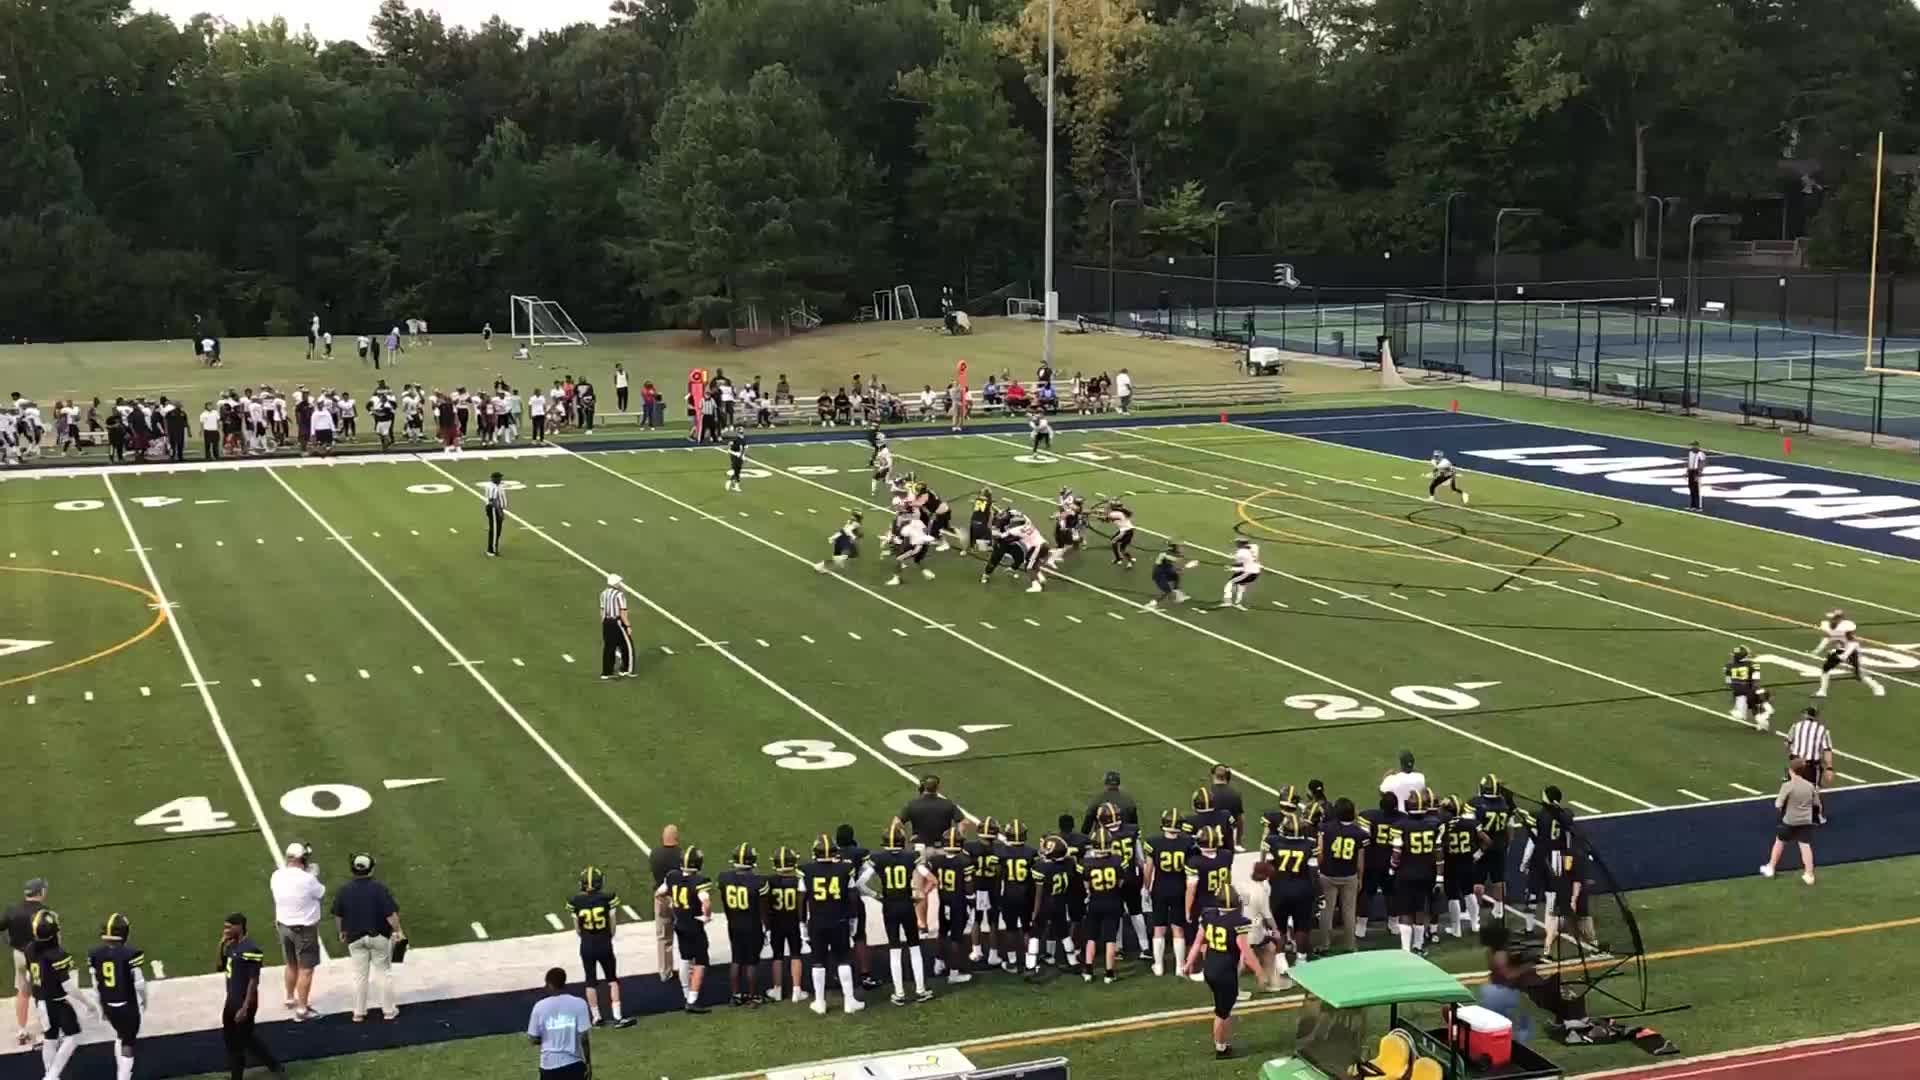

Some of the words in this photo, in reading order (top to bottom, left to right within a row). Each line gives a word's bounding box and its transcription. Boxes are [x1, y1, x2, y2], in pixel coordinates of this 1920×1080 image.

[1330, 836, 1355, 861] 48
[1409, 830, 1434, 854] 55
[1448, 831, 1472, 854] 22
[1006, 858, 1028, 882] 16
[1160, 850, 1185, 873] 20
[1277, 849, 1304, 873] 77
[813, 876, 841, 901] 54
[884, 864, 908, 890] 10
[937, 867, 957, 893] 19
[1052, 872, 1070, 897] 21
[1090, 866, 1117, 892] 29
[671, 884, 690, 910] 14
[725, 884, 749, 911] 60
[771, 887, 796, 911] 30
[578, 906, 607, 931] 35
[1205, 923, 1228, 952] 42
[102, 961, 116, 988] 9
